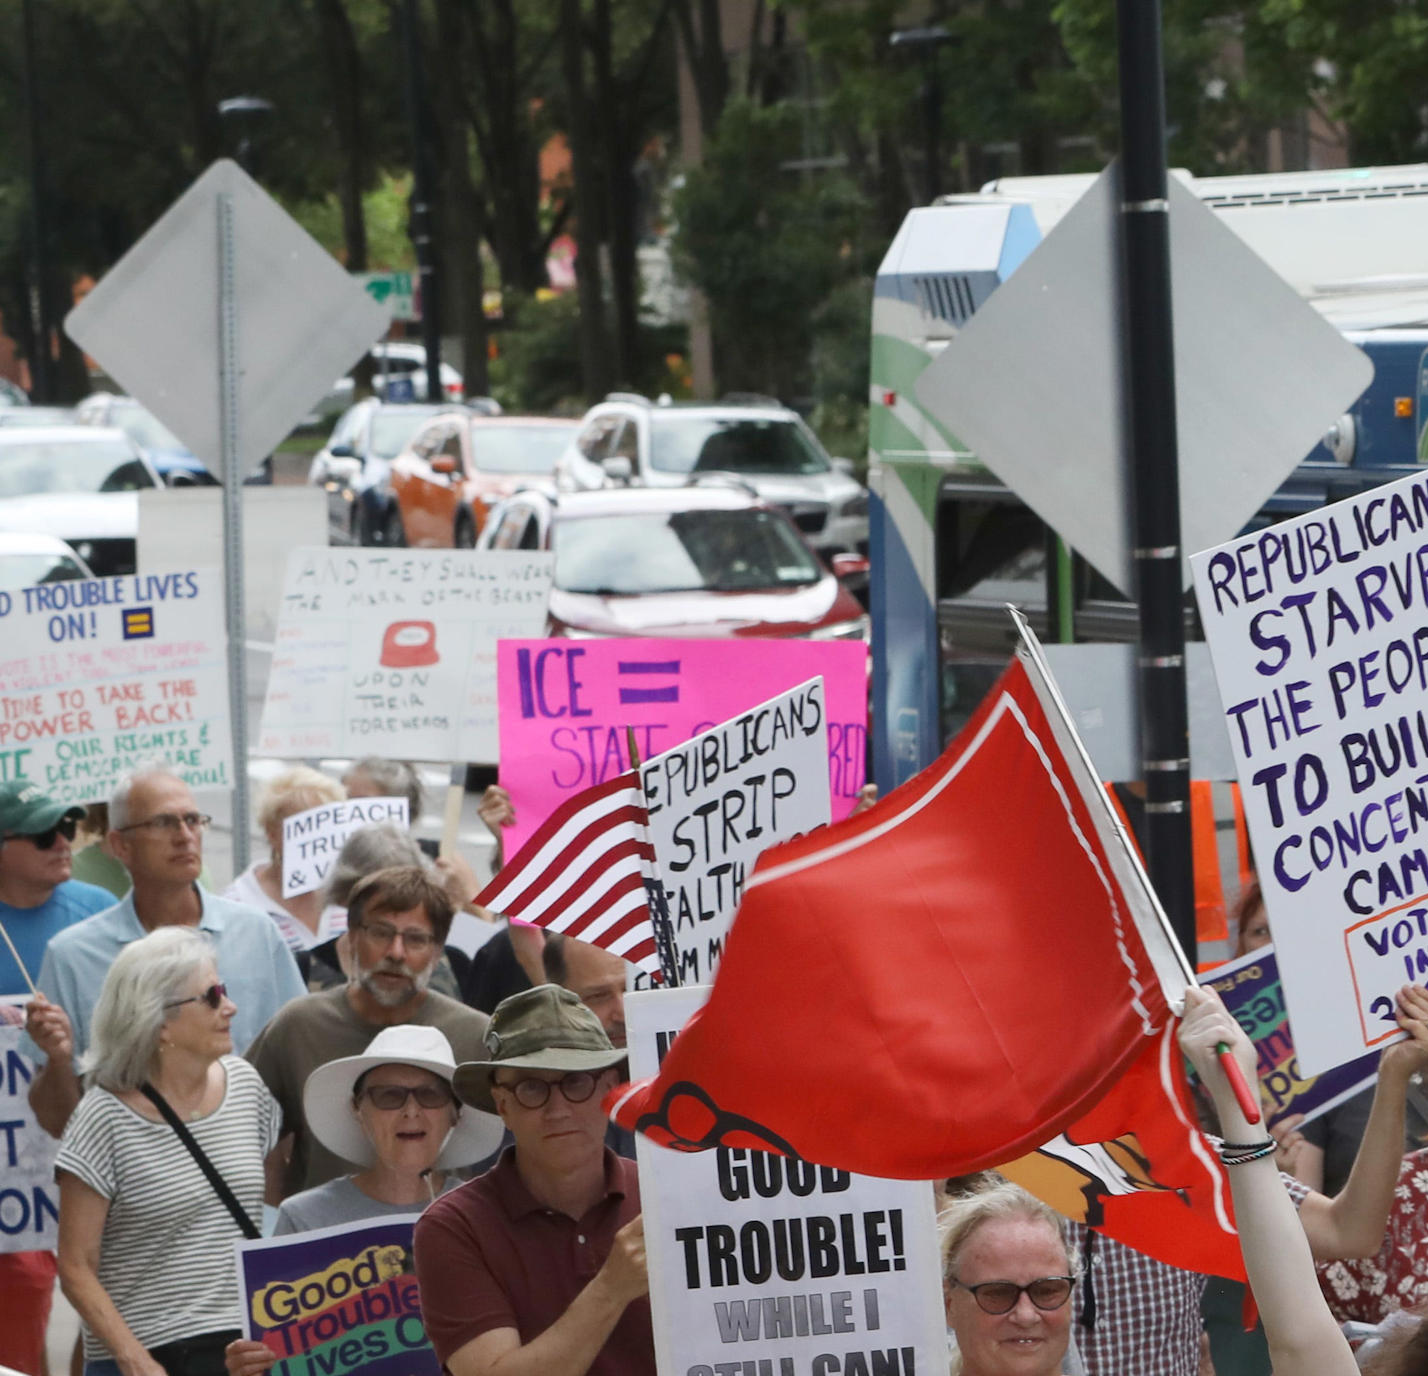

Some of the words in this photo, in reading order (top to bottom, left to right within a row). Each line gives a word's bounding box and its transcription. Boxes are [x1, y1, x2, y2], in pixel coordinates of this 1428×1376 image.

[22, 577, 124, 614] TROUBLE
[135, 571, 199, 601] LIVES
[297, 559, 359, 586] AND
[368, 557, 433, 583] THEY
[48, 611, 97, 642] ON!
[57, 689, 85, 710] TO
[96, 683, 145, 705] TAKE
[158, 679, 198, 700] THE
[353, 671, 430, 688] UPON
[517, 647, 593, 719] ICE
[0, 711, 95, 744] POWER
[115, 701, 196, 730] BACK!
[355, 693, 425, 710] THEIR
[1226, 679, 1324, 758] THE
[55, 738, 103, 762] OUR
[643, 684, 821, 816] EPUBLICANS
[1252, 753, 1328, 828] TO
[286, 803, 404, 840] IMPEACH
[668, 767, 797, 872] STRIP
[297, 832, 346, 859] TRU
[675, 1208, 907, 1289] TROUBLE!
[263, 1251, 380, 1322] Good
[269, 1279, 420, 1355] Trouble
[395, 1313, 428, 1348] O
[714, 1291, 855, 1343] WHILE
[863, 1289, 881, 1331] I
